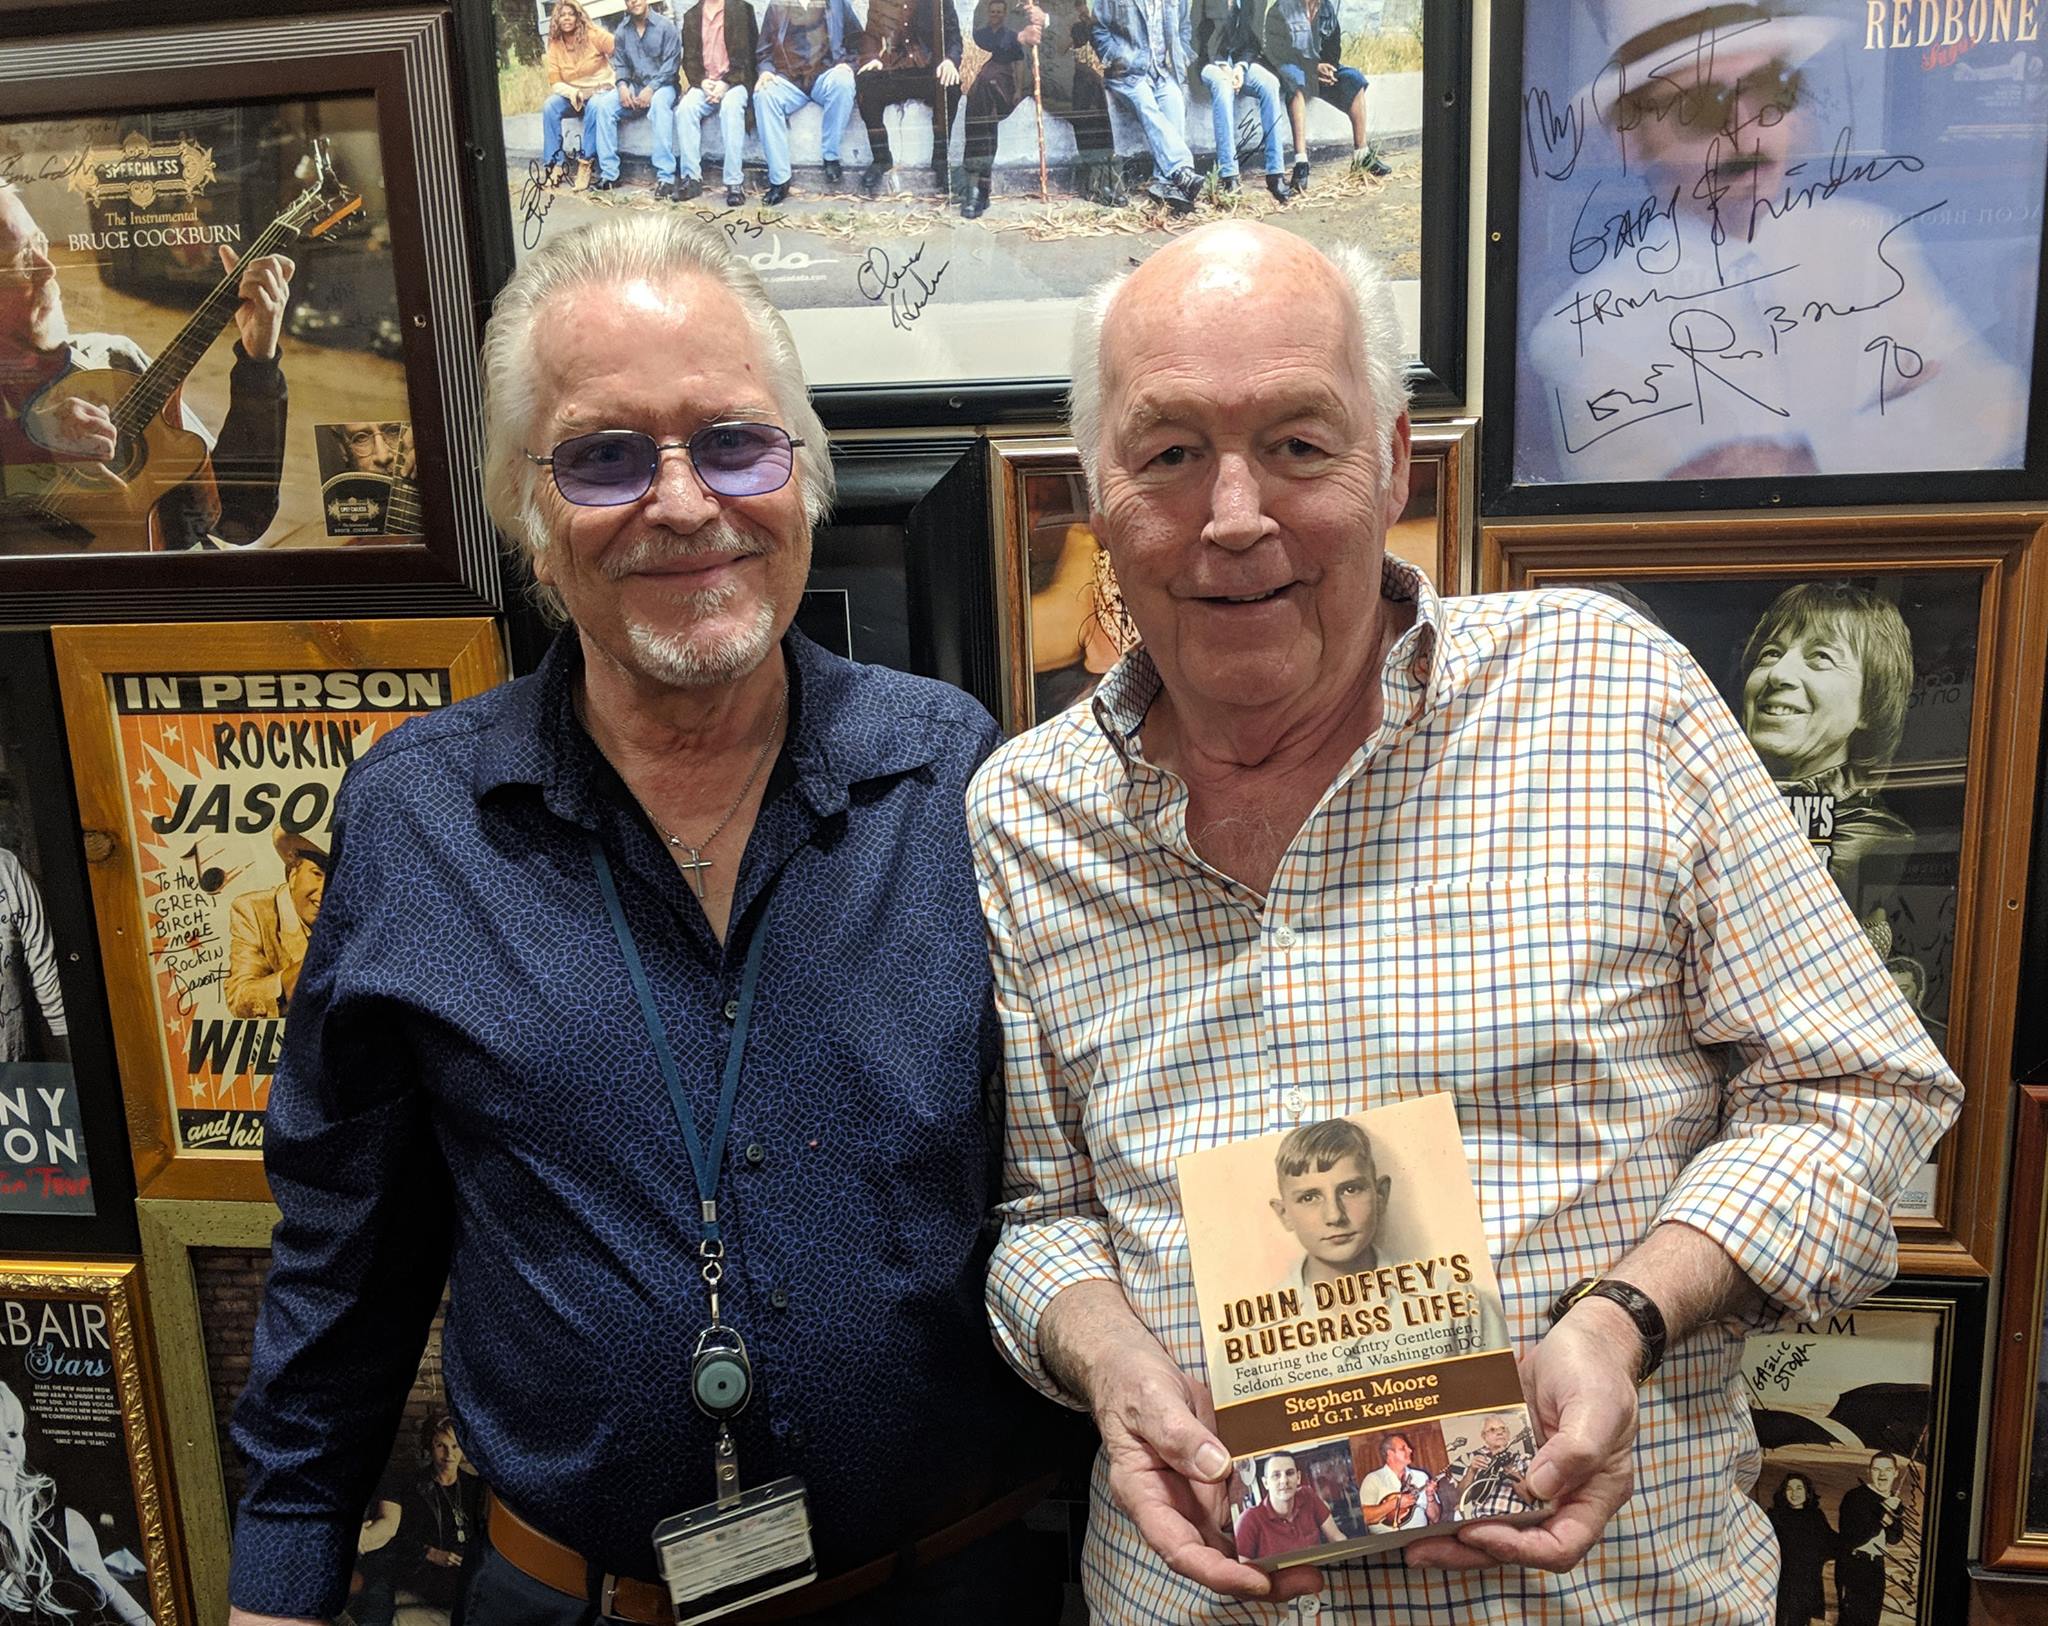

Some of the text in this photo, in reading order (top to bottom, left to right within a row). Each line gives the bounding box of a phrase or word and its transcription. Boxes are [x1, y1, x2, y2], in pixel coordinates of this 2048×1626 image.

[1863, 0, 2038, 49] REDBONE
[105, 159, 180, 179] SPEECHLESS
[104, 207, 199, 226] The Instrumental
[68, 224, 242, 251] BRUCE COCKBURN
[124, 672, 442, 710] IN PERSON
[212, 719, 362, 770] ROCKIN'
[152, 782, 335, 835] JASO
[1785, 796, 1834, 837] N'S
[155, 866, 199, 892] To the
[0, 1087, 66, 1126] NY
[4, 1127, 78, 1164] ON
[187, 1111, 264, 1146] and his
[1217, 1254, 1474, 1333] JOHN DUFFEY'S
[1224, 1291, 1480, 1365] BLUEGRASS LIFE:
[25, 1341, 112, 1381] Stars
[1233, 1374, 1284, 1396] Seldom
[1288, 1366, 1334, 1385] Scene,
[1337, 1357, 1363, 1373] and
[1369, 1342, 1453, 1368] Washington
[1235, 1323, 1479, 1380] Featuring the Country Gentlemen,
[1285, 1373, 1439, 1415] Stephen Moore
[1291, 1393, 1440, 1432] and G.T. Keplinger
